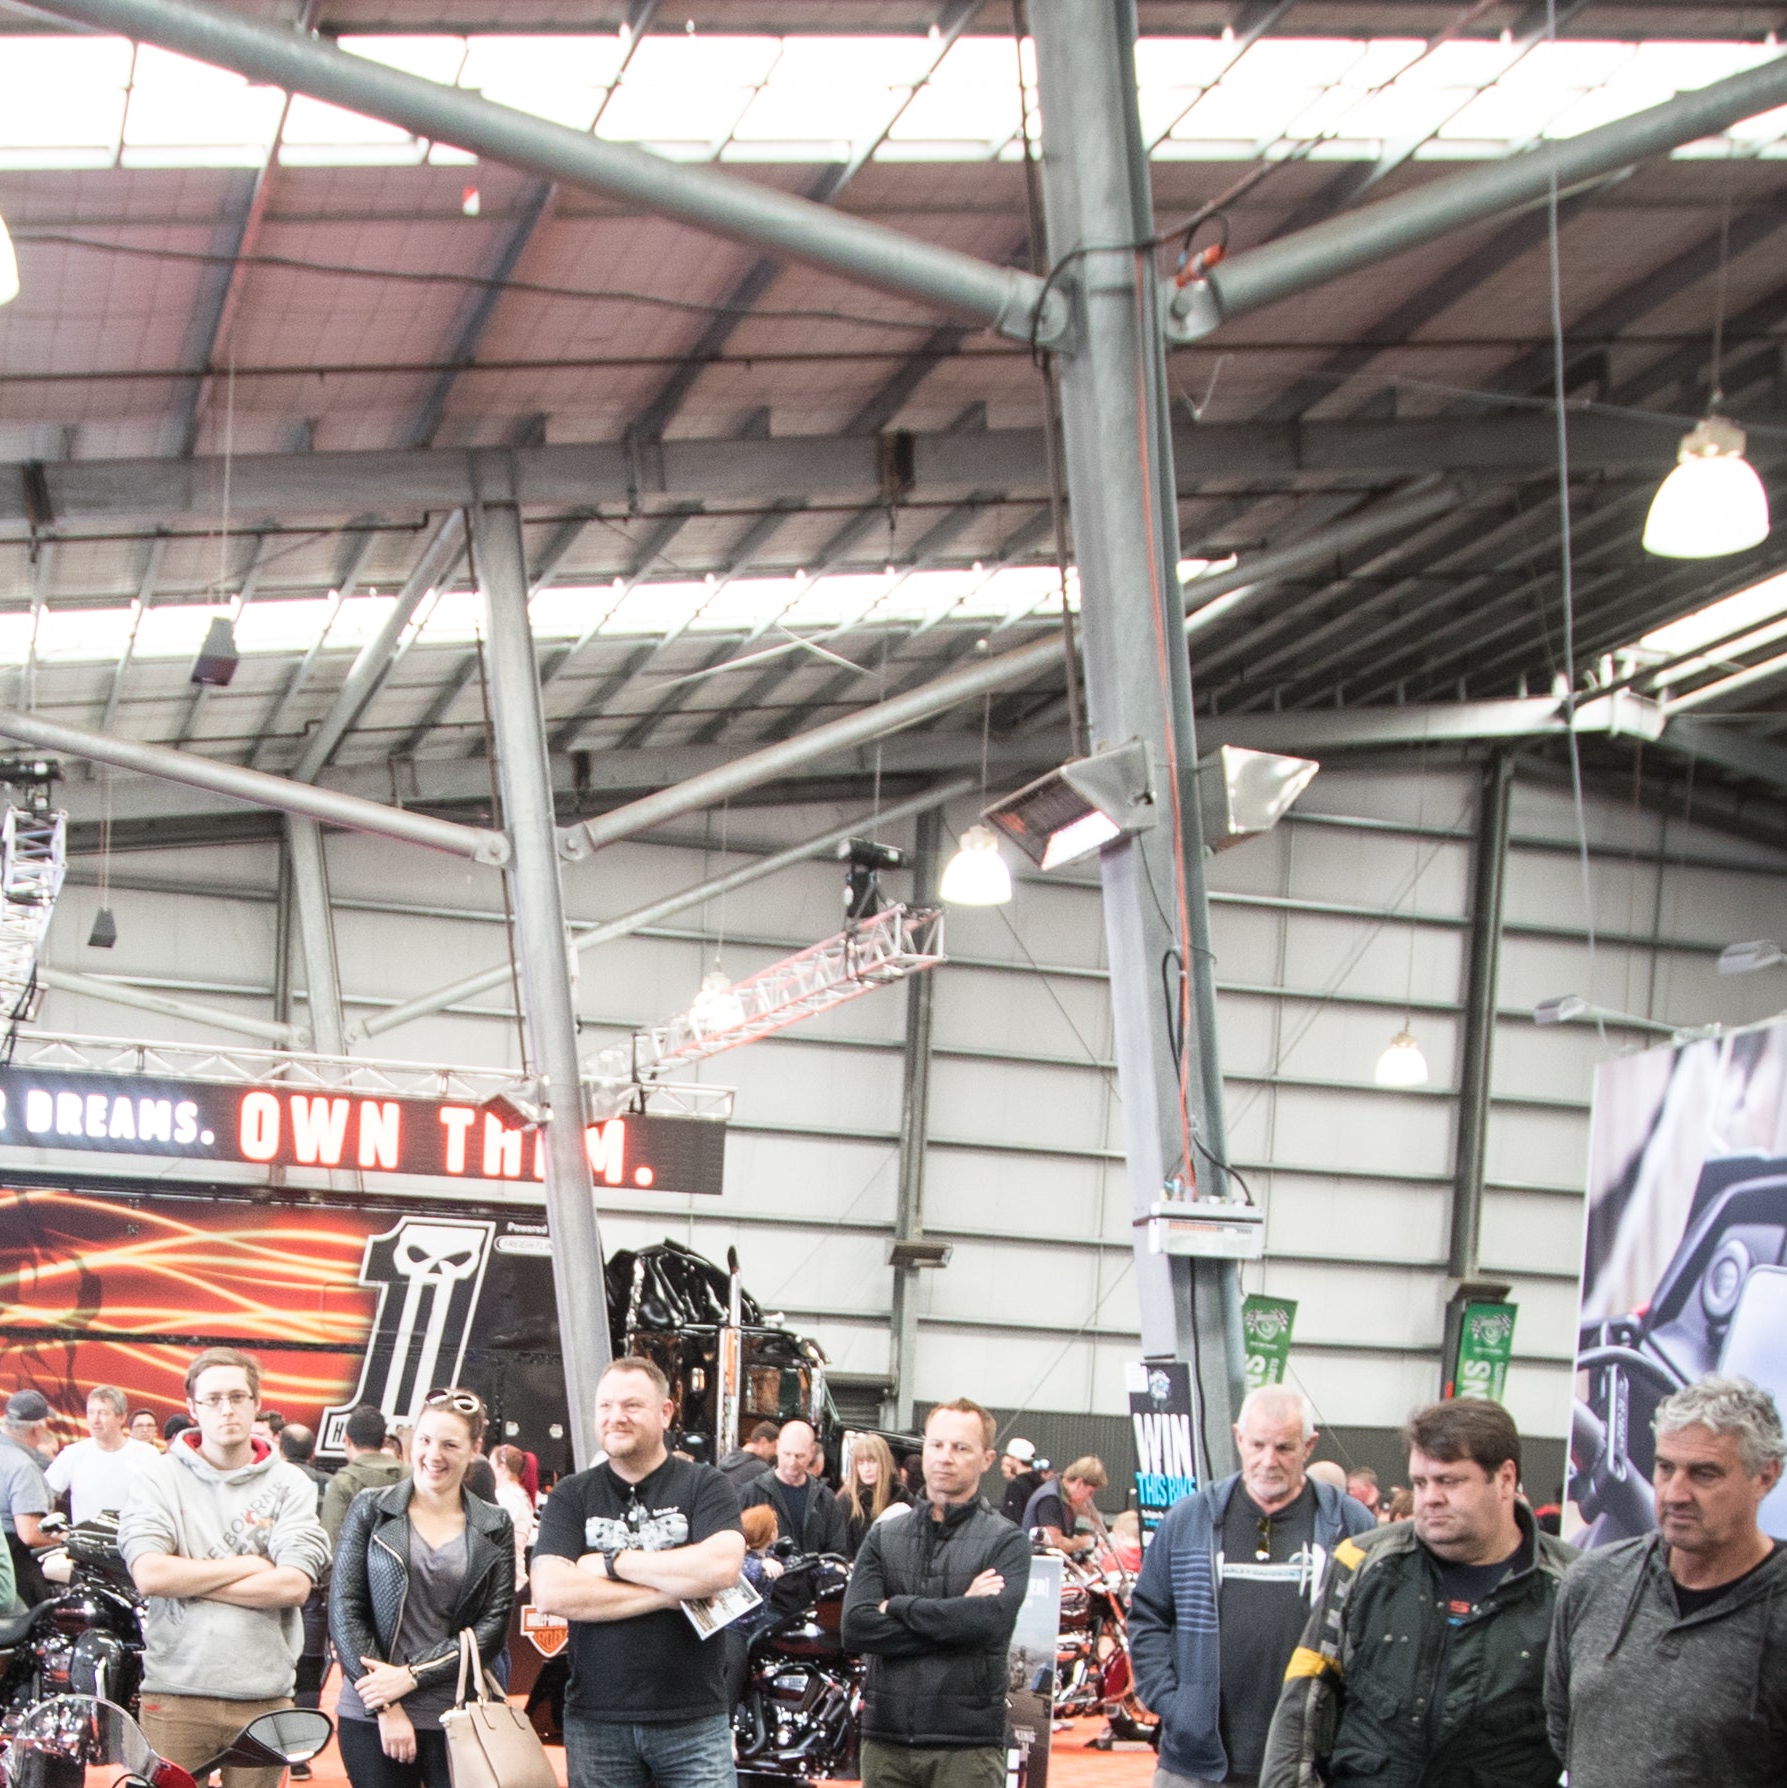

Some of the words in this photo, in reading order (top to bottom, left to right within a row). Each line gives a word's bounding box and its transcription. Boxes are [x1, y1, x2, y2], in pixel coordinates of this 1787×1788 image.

[26, 1089, 215, 1146] DREAMS.
[240, 1091, 401, 1169] OWN
[507, 1221, 548, 1235] Powered
[1132, 1412, 1194, 1478] WIN
[1135, 1471, 1168, 1507] THIS
